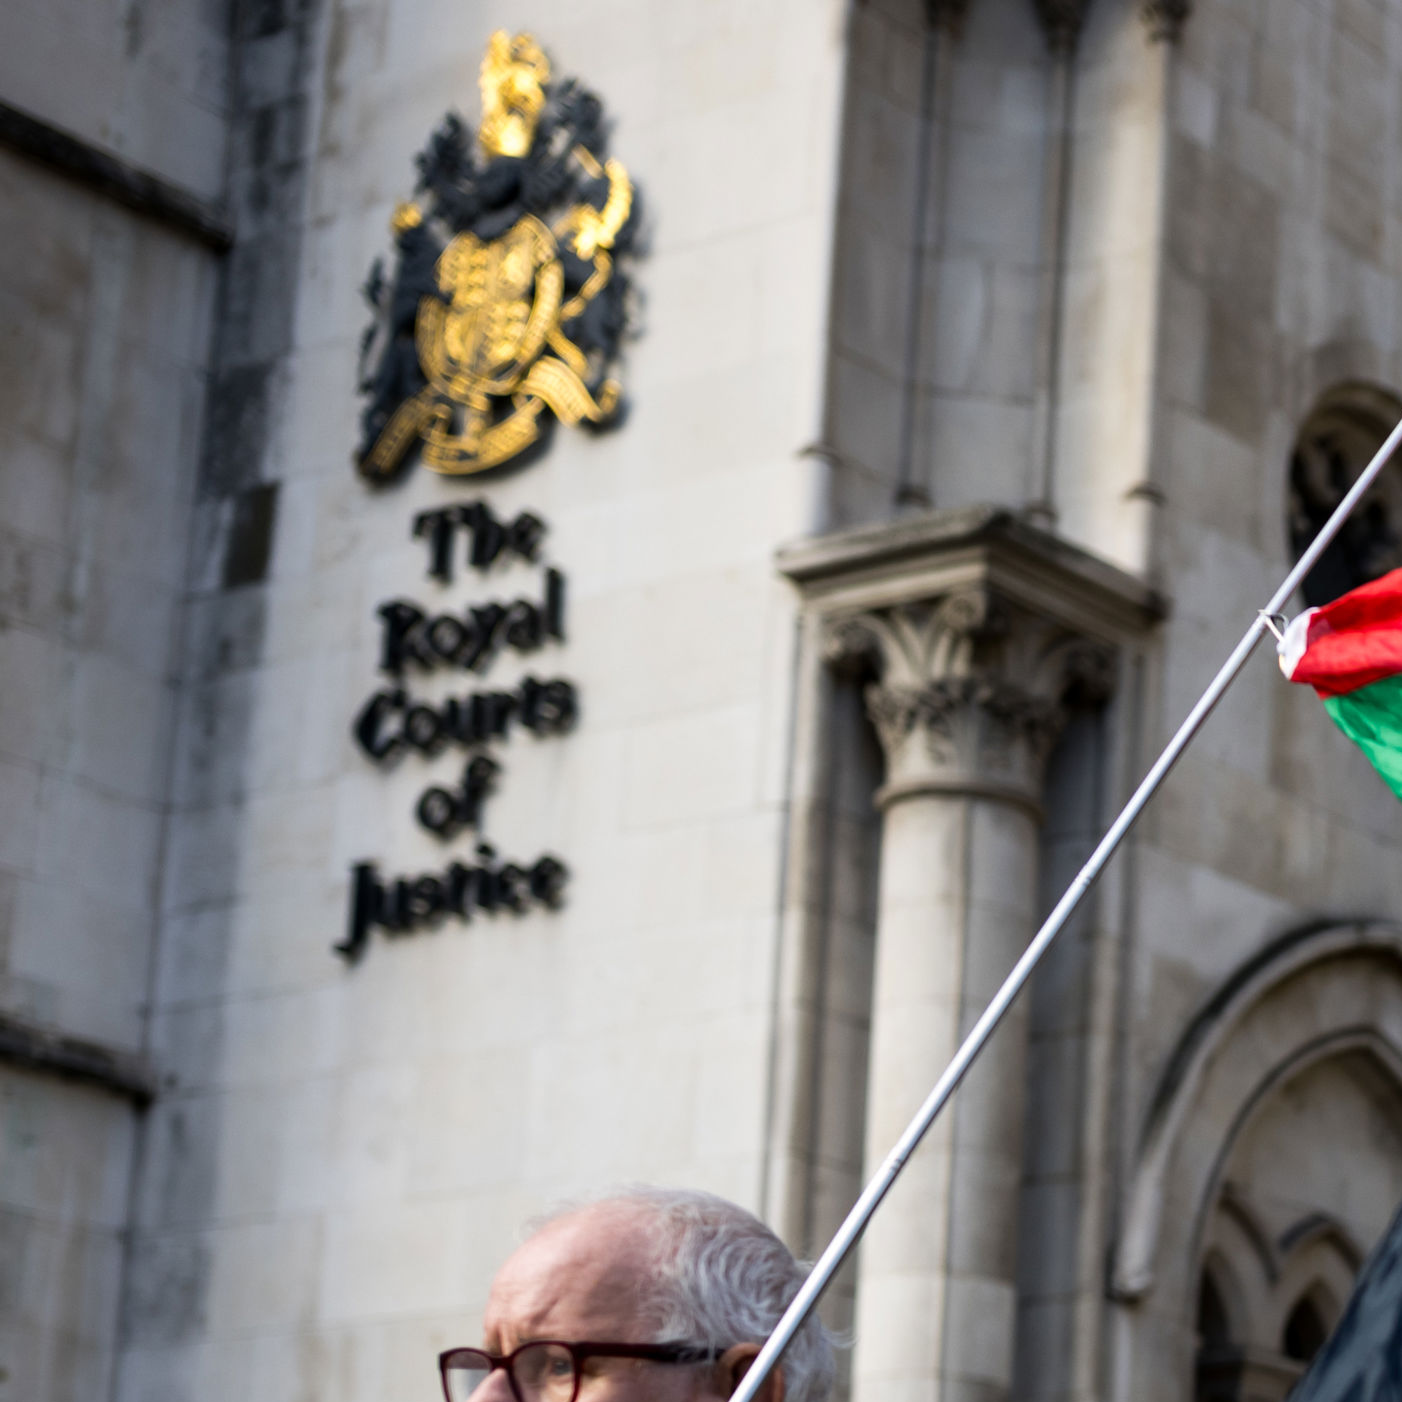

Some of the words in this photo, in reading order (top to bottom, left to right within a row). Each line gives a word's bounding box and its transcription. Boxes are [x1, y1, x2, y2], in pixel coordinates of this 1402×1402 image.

[412, 499, 546, 586] The
[377, 567, 566, 674] Royal
[416, 752, 502, 842] of
[334, 840, 570, 966] Justice
